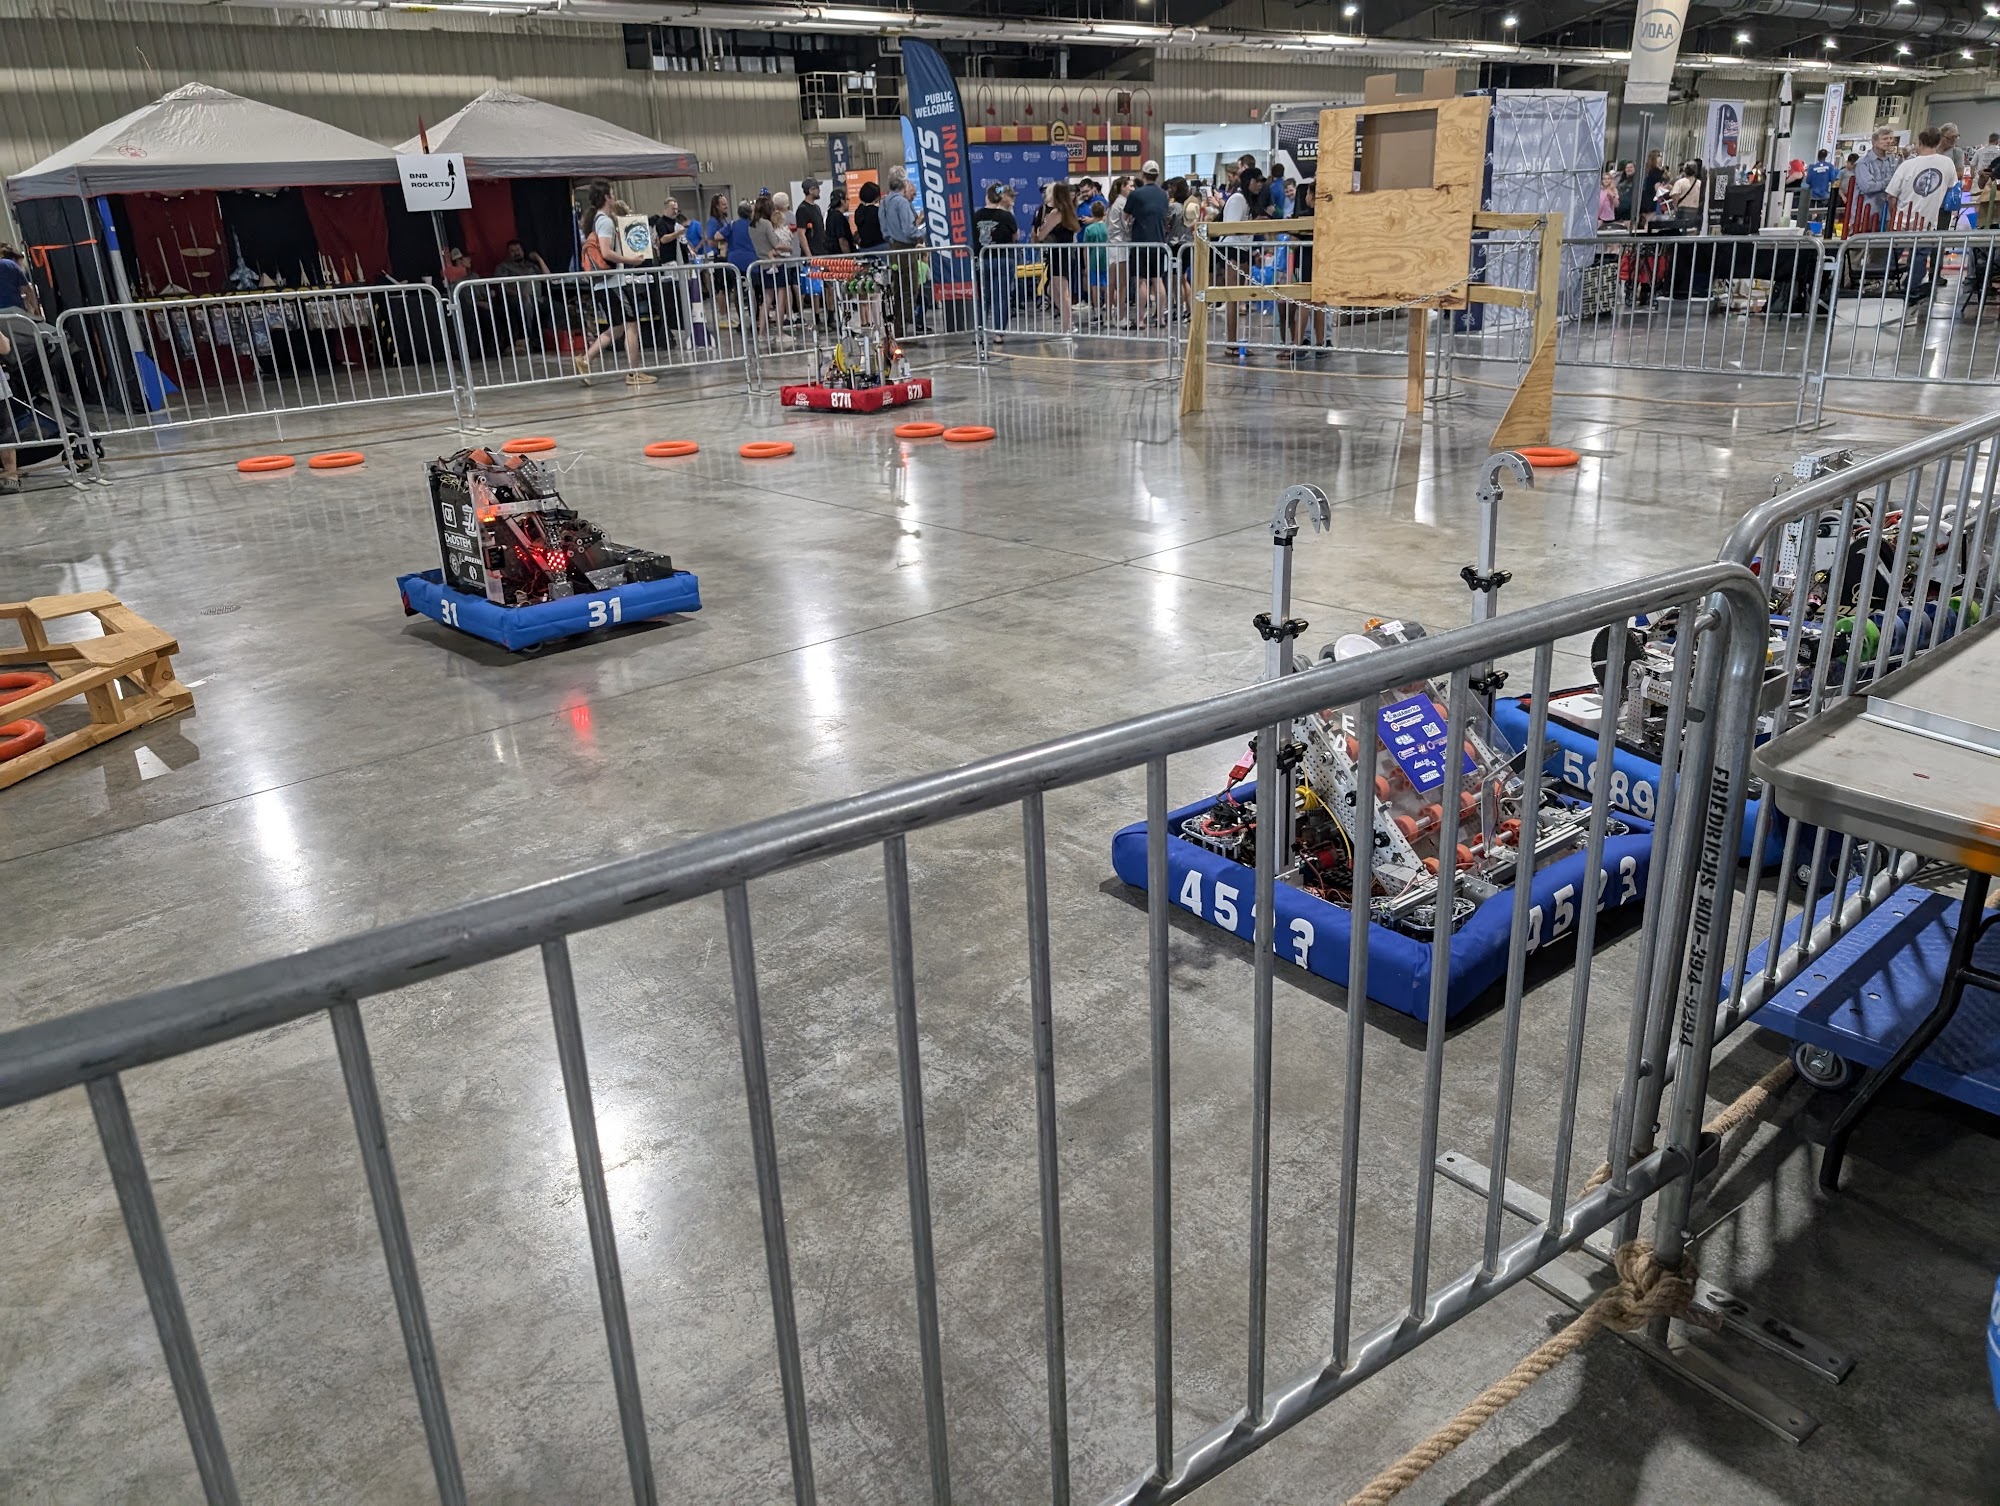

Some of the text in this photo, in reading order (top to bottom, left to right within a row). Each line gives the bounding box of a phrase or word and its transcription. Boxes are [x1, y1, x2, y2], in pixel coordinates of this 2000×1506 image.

[915, 102, 955, 118] WELCOME
[925, 91, 954, 105] PUBLIC
[833, 139, 847, 176] ATM
[917, 126, 951, 259] ROBOTS
[941, 124, 968, 258] FREE FUN!
[831, 392, 852, 408] 8711
[464, 555, 482, 566] BOEIN
[441, 599, 460, 627] 31
[588, 597, 622, 628] 31
[1700, 766, 1730, 889] FRIEDRICHS
